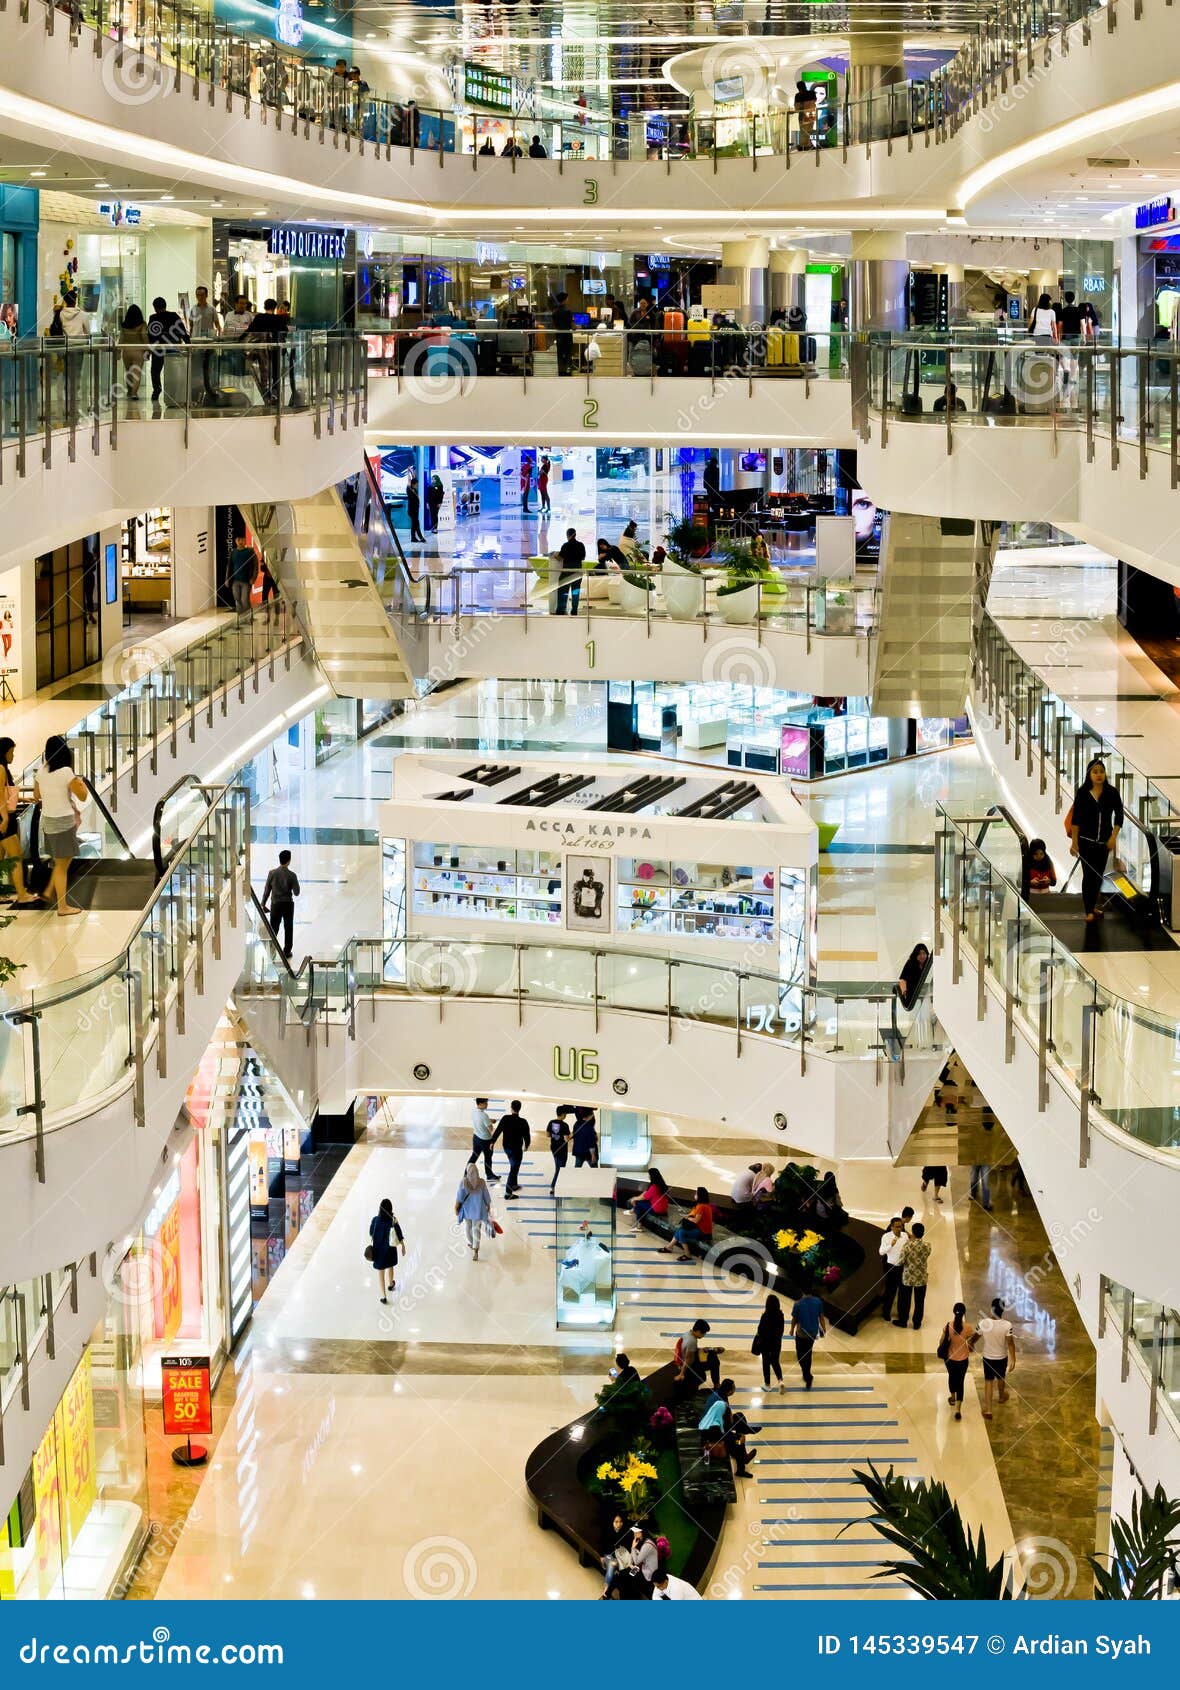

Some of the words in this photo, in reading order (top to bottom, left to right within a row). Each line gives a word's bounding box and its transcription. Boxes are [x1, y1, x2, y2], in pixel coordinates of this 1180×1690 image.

[583, 178, 599, 205] 3
[271, 228, 347, 259] HEADQUARTERS
[583, 399, 599, 428] 2
[585, 640, 595, 669] 1
[526, 819, 575, 834] ACCA
[588, 824, 652, 839] KAPPA
[583, 838, 615, 850] 1869
[554, 1045, 599, 1084] UG
[169, 1376, 202, 1389] SALE
